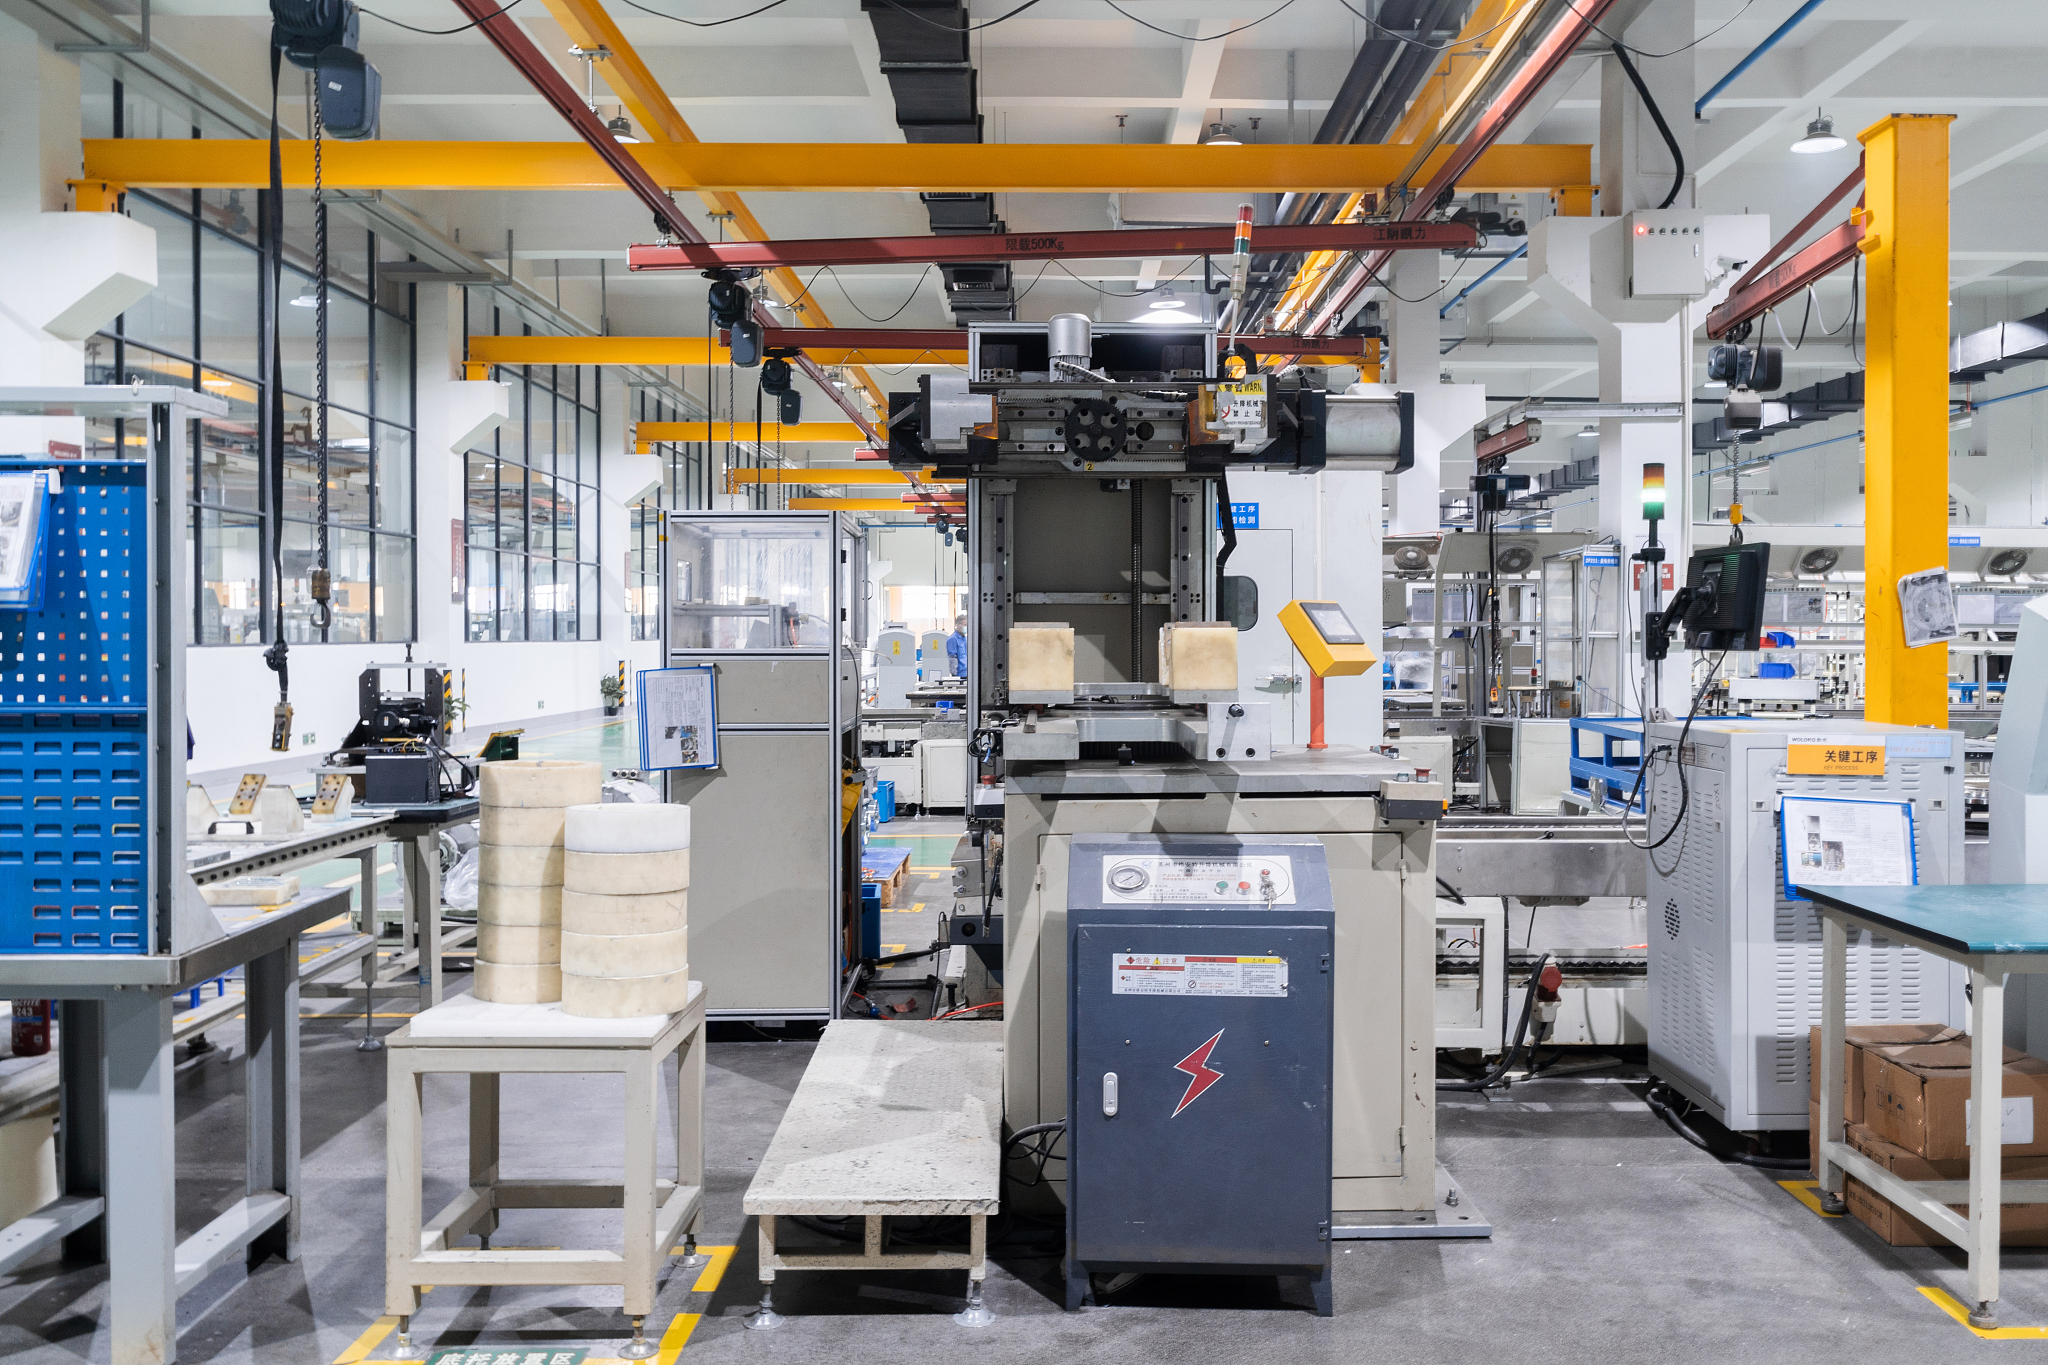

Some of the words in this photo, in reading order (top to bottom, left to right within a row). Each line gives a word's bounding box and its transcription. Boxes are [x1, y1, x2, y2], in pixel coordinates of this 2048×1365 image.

[1087, 463, 1093, 471] 2
[1824, 749, 1878, 763] 关键工序
